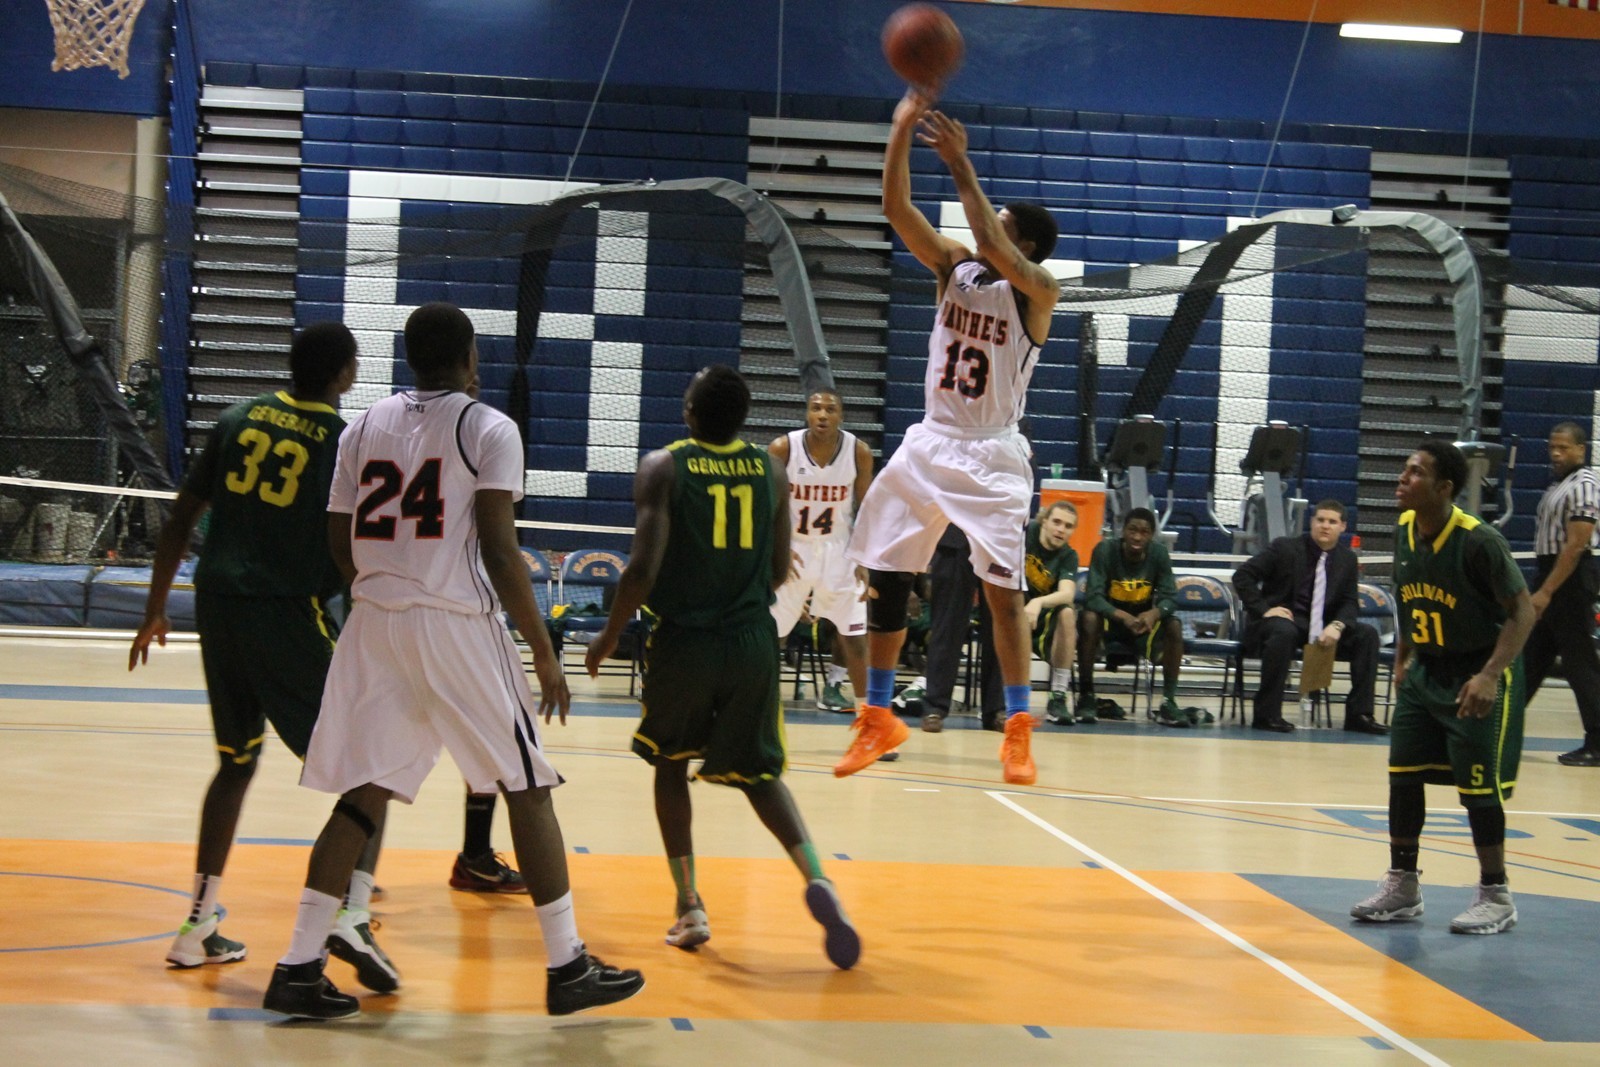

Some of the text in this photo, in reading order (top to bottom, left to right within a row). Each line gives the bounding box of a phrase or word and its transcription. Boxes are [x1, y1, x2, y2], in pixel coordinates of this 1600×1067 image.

[938, 301, 1008, 346] PANTHES
[939, 340, 989, 400] 13
[247, 405, 328, 442] GENERALS
[225, 427, 309, 507] 33
[354, 457, 444, 541] 24
[707, 483, 753, 549] 11
[797, 505, 834, 535] 14
[1411, 609, 1444, 647] 31
[1470, 764, 1484, 786] S
